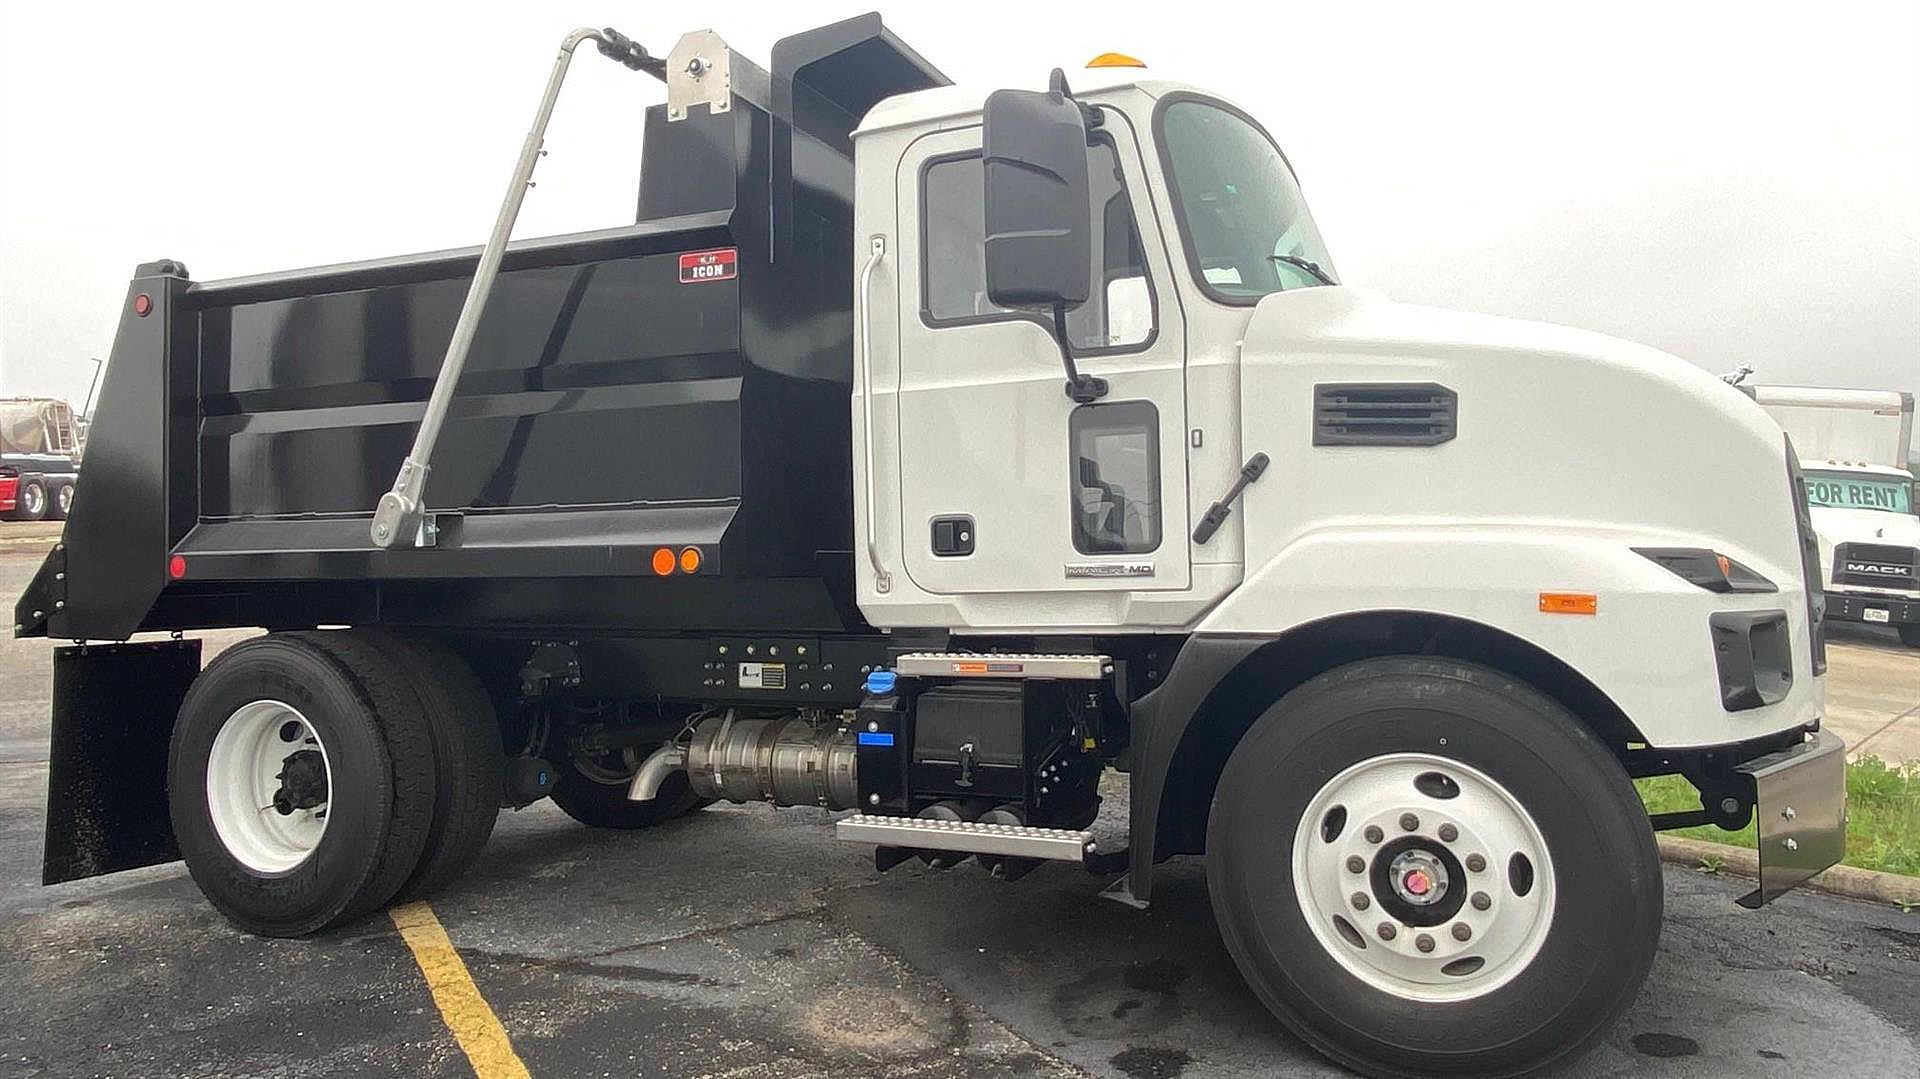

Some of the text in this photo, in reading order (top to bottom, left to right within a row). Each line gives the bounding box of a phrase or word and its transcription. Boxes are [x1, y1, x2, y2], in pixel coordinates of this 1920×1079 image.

[692, 264, 724, 278] ICON
[1805, 482, 1897, 508] FOR RENT
[1848, 564, 1908, 575] MACK
